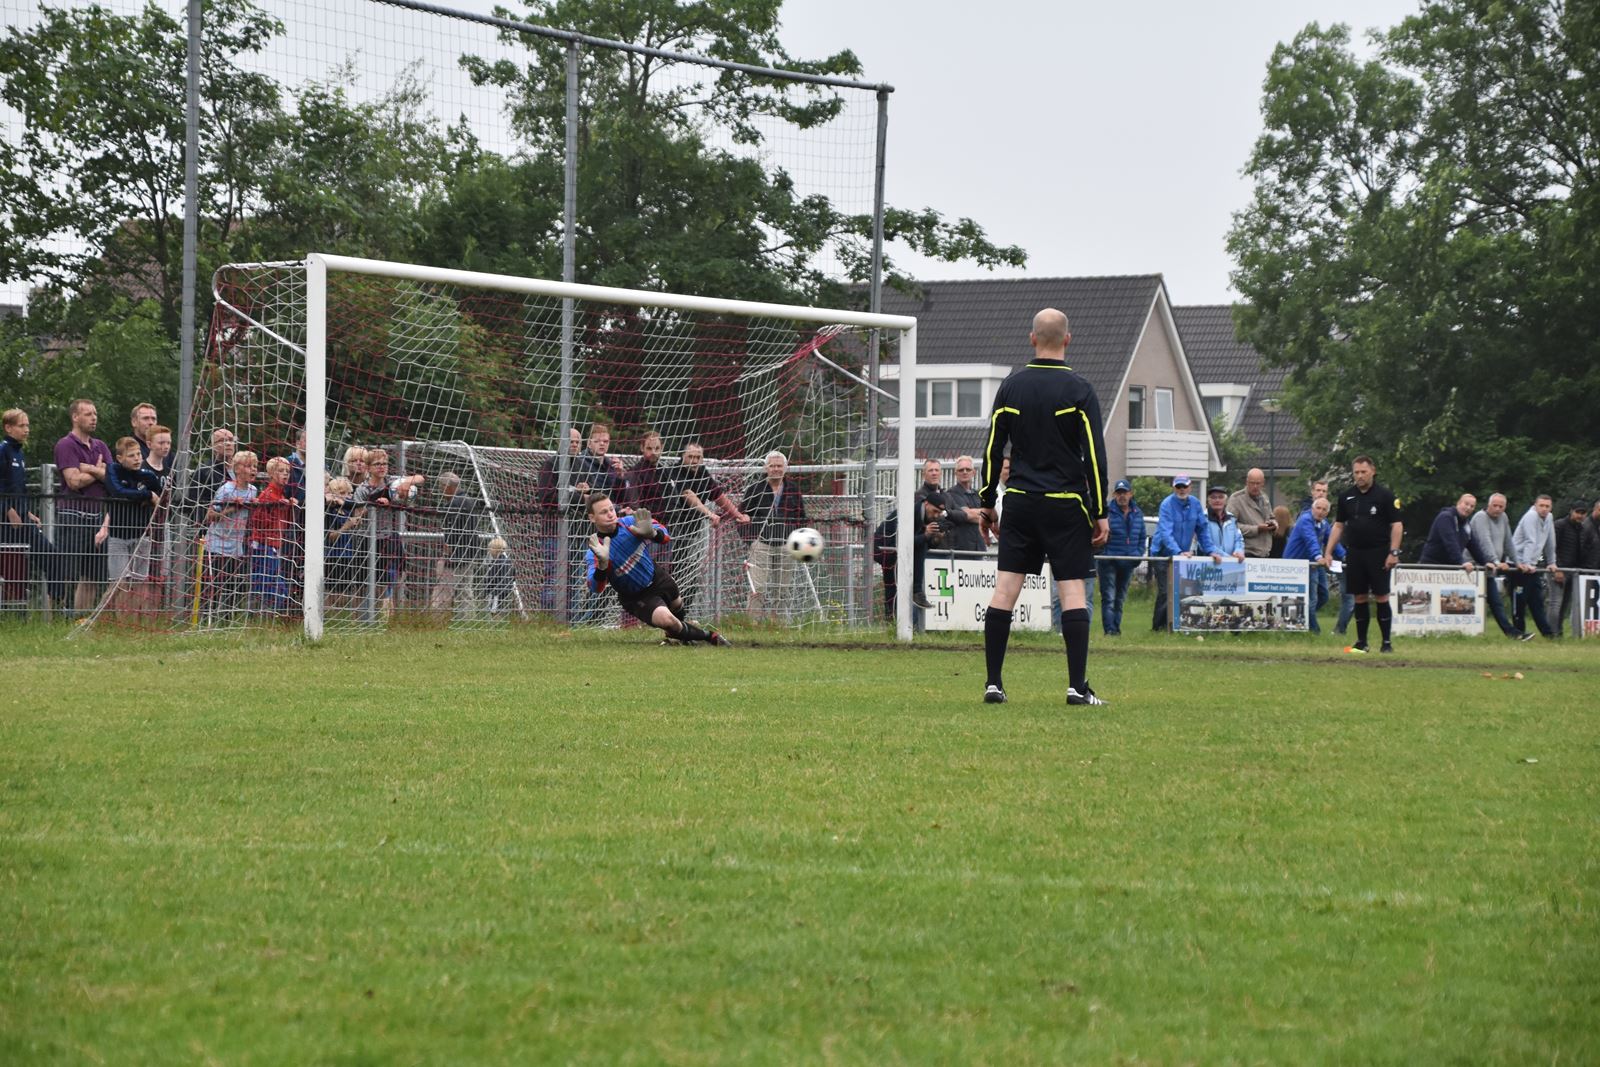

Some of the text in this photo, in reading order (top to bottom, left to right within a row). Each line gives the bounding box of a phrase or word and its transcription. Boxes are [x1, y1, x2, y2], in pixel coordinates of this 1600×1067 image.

[958, 568, 1047, 590] Bouwbed enstra
[1186, 563, 1223, 581] Welkom
[1020, 604, 1031, 623] BV
